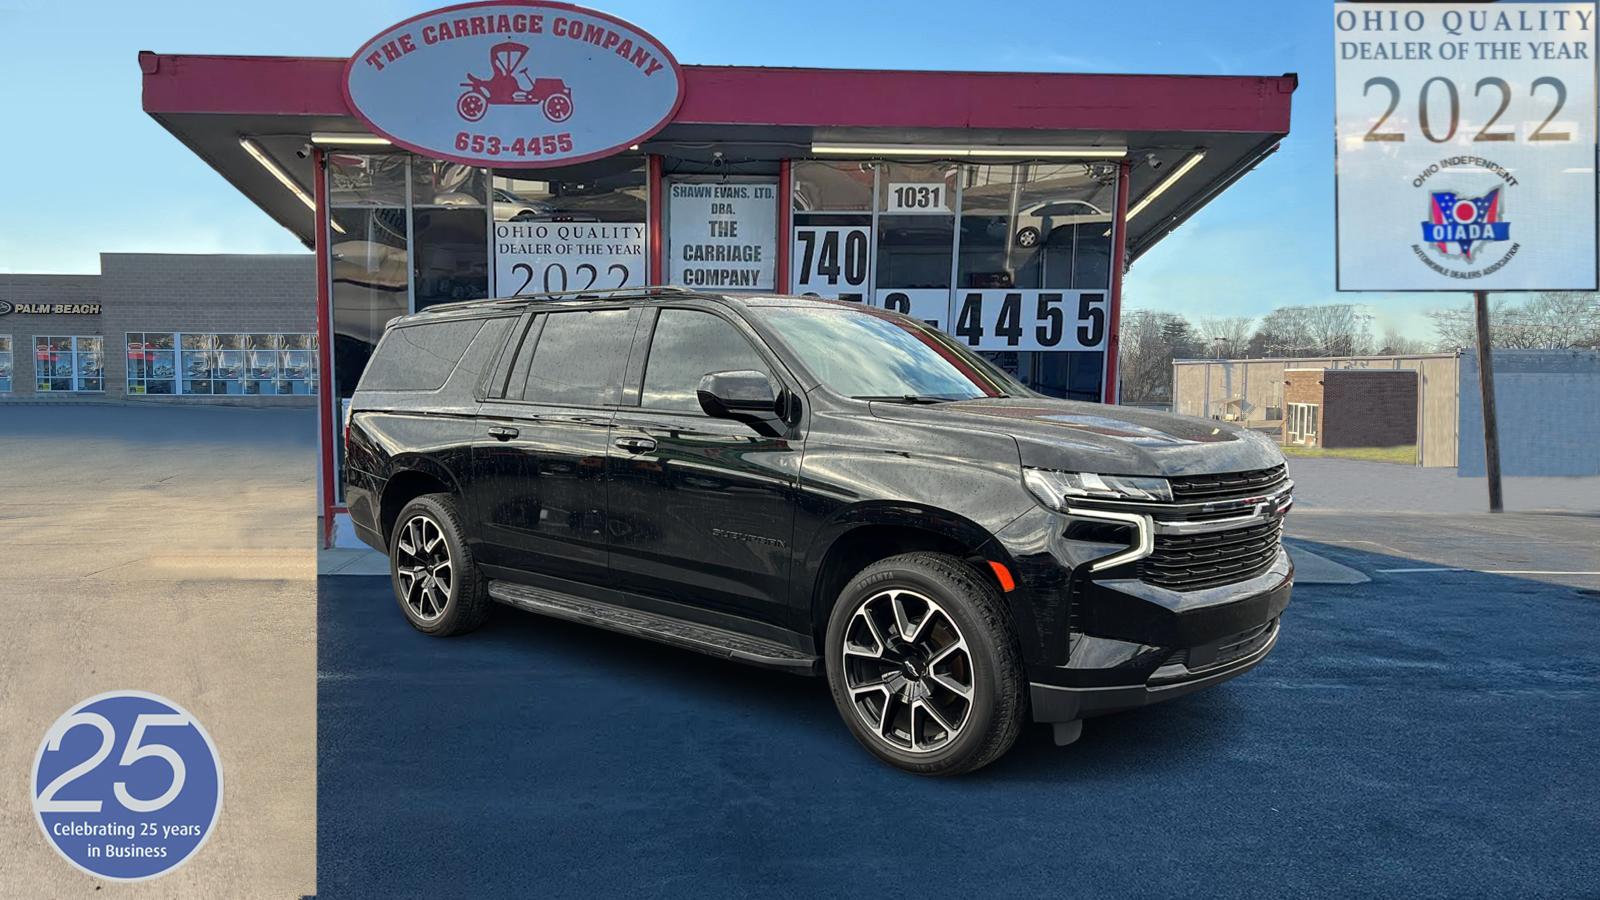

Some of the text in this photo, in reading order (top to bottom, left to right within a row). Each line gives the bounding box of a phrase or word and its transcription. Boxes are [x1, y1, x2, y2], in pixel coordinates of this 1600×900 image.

[1336, 10, 1593, 35] OHIO QUALITY
[365, 14, 664, 78] THE CARRIAGE COMPANY
[1340, 41, 1589, 60] DEALER OF THE YEAR
[1363, 76, 1571, 143] 2022
[454, 131, 573, 156] 653-4455
[1412, 156, 1519, 188] OHIO INDEPENDENT
[672, 185, 713, 199] SHAWN
[894, 186, 941, 208] 1031
[711, 203, 736, 215] DBA.
[497, 226, 644, 241] OHIO QUALITY
[708, 220, 738, 237] THE
[1432, 224, 1495, 240] OIADA
[499, 243, 642, 255] DEALER OF THE YEAR
[683, 244, 762, 262] CARRIAGE
[797, 229, 868, 285] 740
[1450, 270, 1482, 280] DEALERS
[1483, 242, 1520, 277] ASSOCIATION
[683, 268, 760, 287] COMPANY
[15, 303, 100, 314] PALM BEACH
